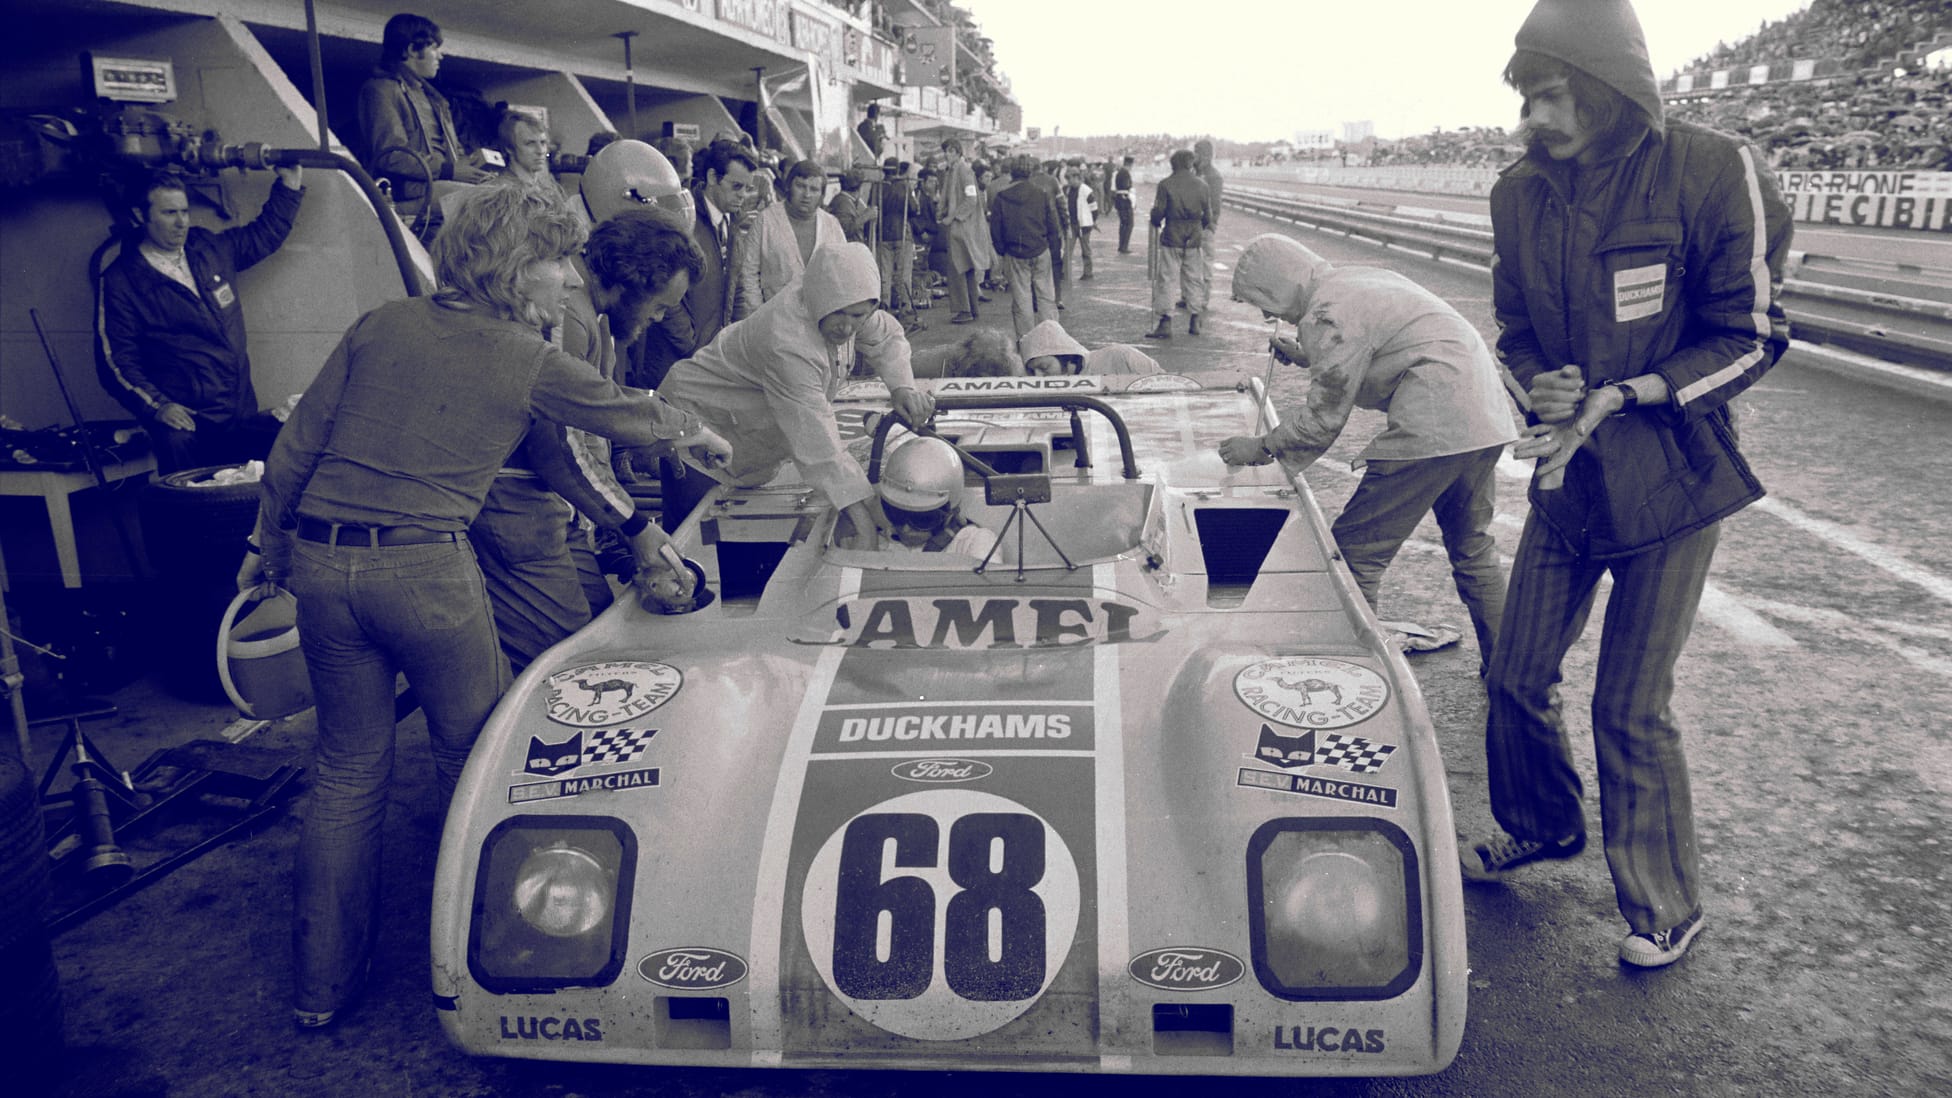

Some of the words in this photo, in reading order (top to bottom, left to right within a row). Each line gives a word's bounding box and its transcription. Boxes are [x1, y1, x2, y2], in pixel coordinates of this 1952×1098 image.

[940, 378, 1097, 392] AMANDA
[786, 599, 1168, 649] AMEL
[1241, 684, 1382, 726] RACING-TEAM
[838, 714, 1072, 743] DUCKHAMS
[564, 771, 652, 795] MARCHAL
[909, 759, 973, 778] Ford
[1296, 777, 1390, 804] MARCHAL
[832, 812, 1047, 1002] 68
[658, 952, 726, 982] Ford
[1150, 952, 1221, 982] Ford
[500, 1015, 603, 1042] LUCAS
[1273, 1025, 1386, 1054] LUCAS
